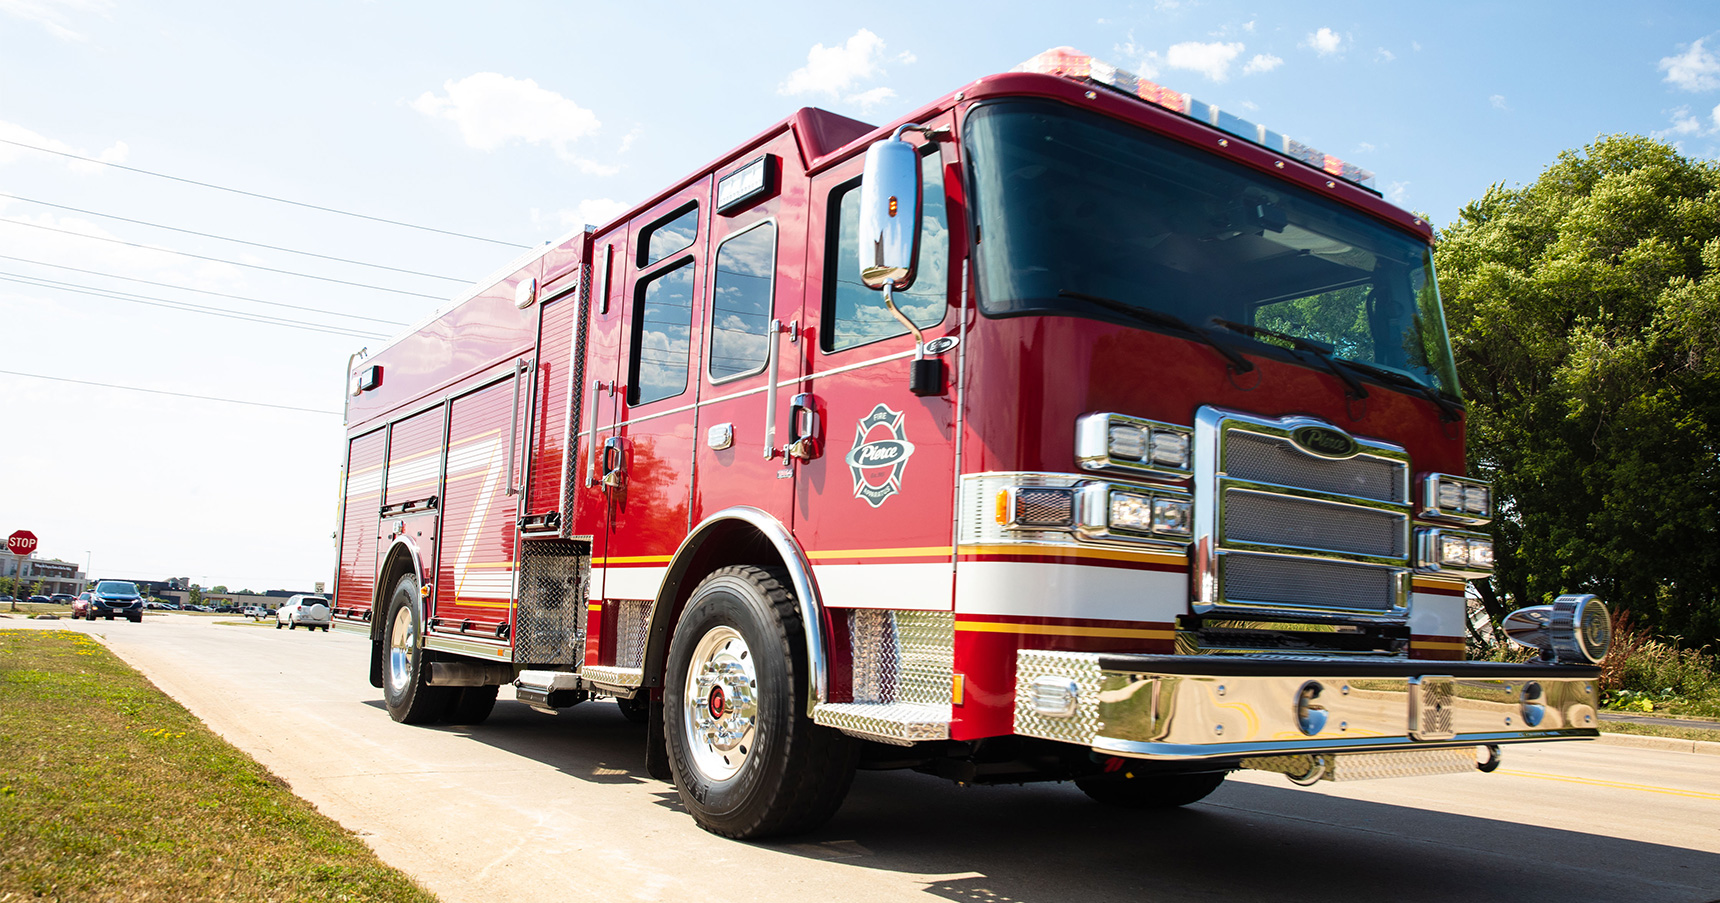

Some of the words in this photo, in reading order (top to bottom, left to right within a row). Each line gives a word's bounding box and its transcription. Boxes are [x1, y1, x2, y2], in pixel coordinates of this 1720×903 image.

[873, 412, 887, 420] FIRE
[858, 445, 898, 465] Pierce
[9, 537, 36, 548] STOP
